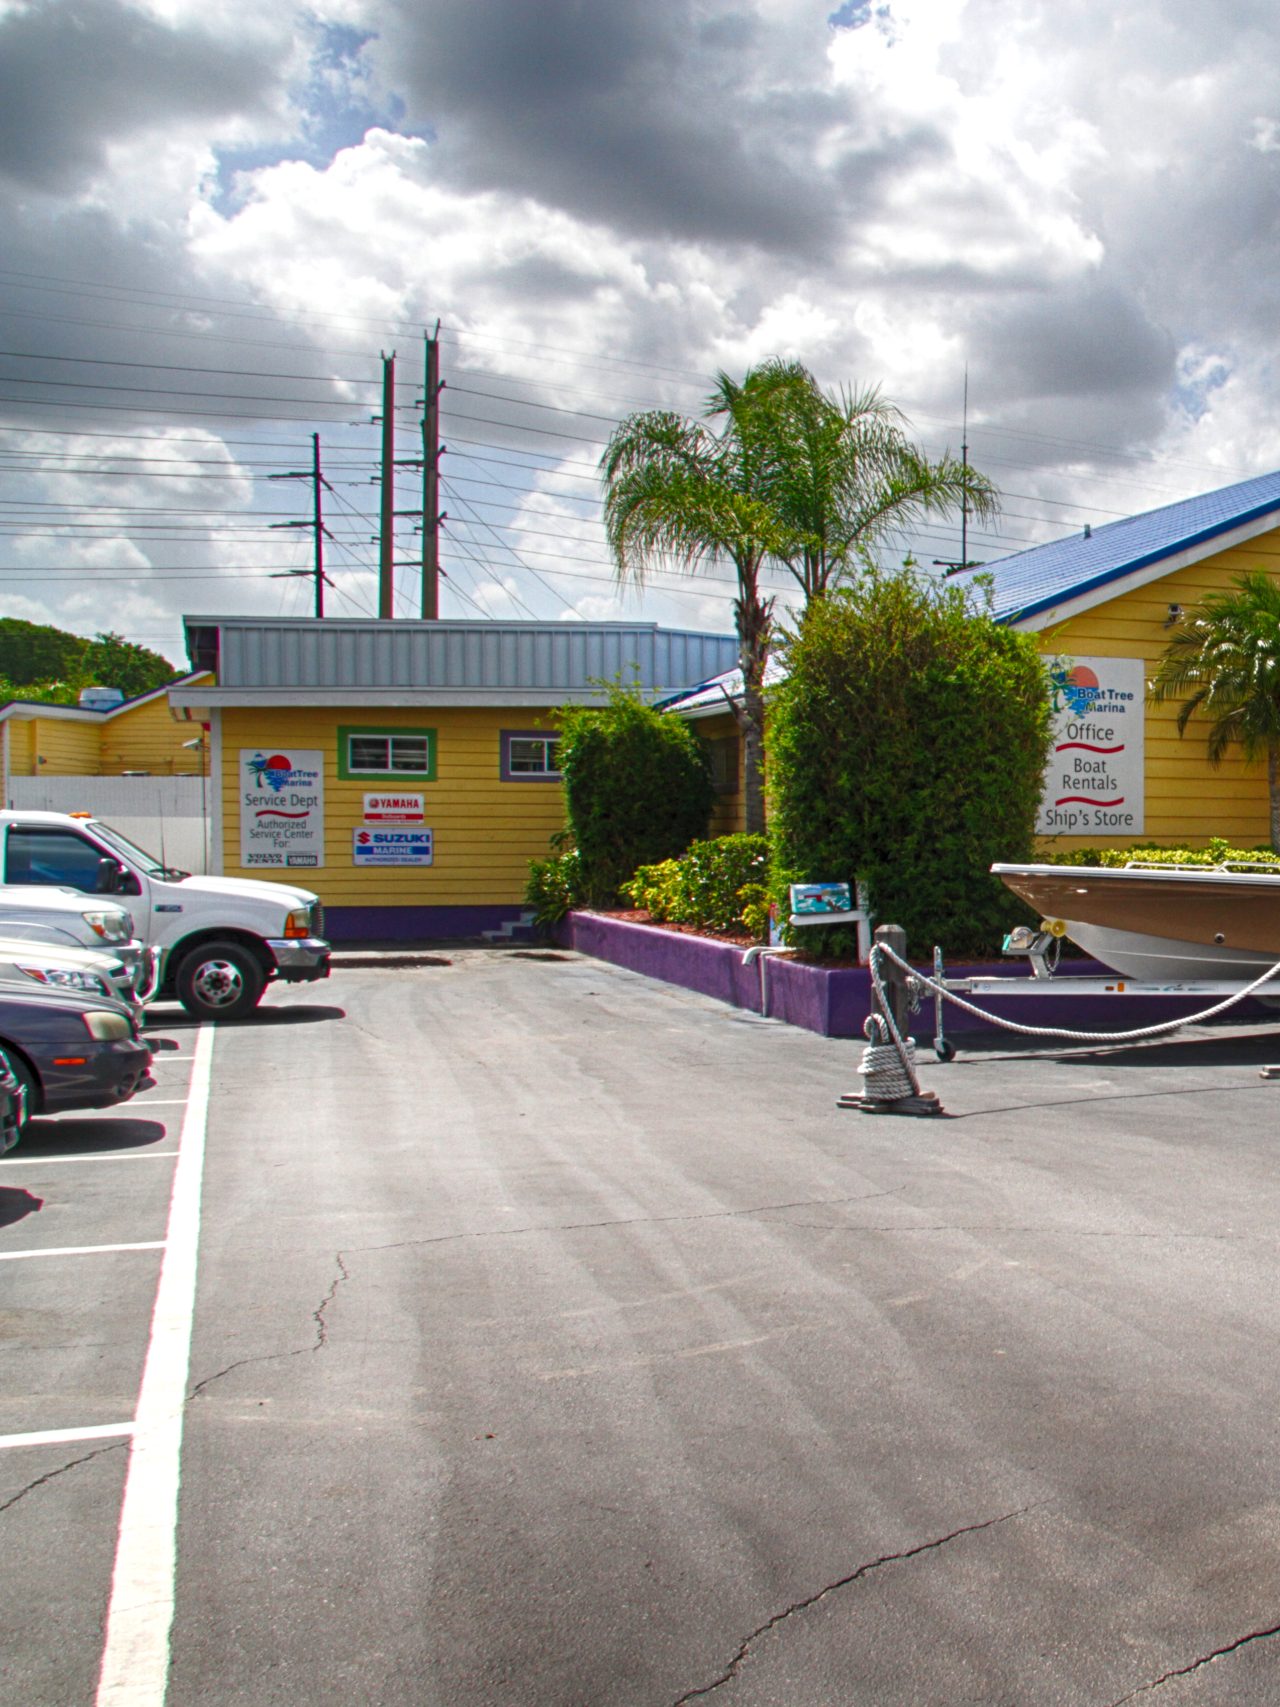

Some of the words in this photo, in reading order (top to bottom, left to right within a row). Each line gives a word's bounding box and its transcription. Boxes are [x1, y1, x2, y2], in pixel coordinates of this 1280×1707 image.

[1085, 702, 1126, 713] Marina
[1067, 723, 1114, 741] Office
[1074, 758, 1107, 773] Boat
[1063, 775, 1117, 790] Rentals
[245, 794, 287, 806] Service
[291, 794, 318, 808] Dept
[381, 799, 419, 808] YAMAHA
[257, 820, 306, 829] Authorized
[1046, 810, 1089, 829] Ship's
[1095, 810, 1133, 826] Store
[250, 830, 278, 839] Service
[281, 830, 313, 839] Center
[373, 833, 430, 843] SUZUKI
[288, 856, 317, 865] YAMAHA
